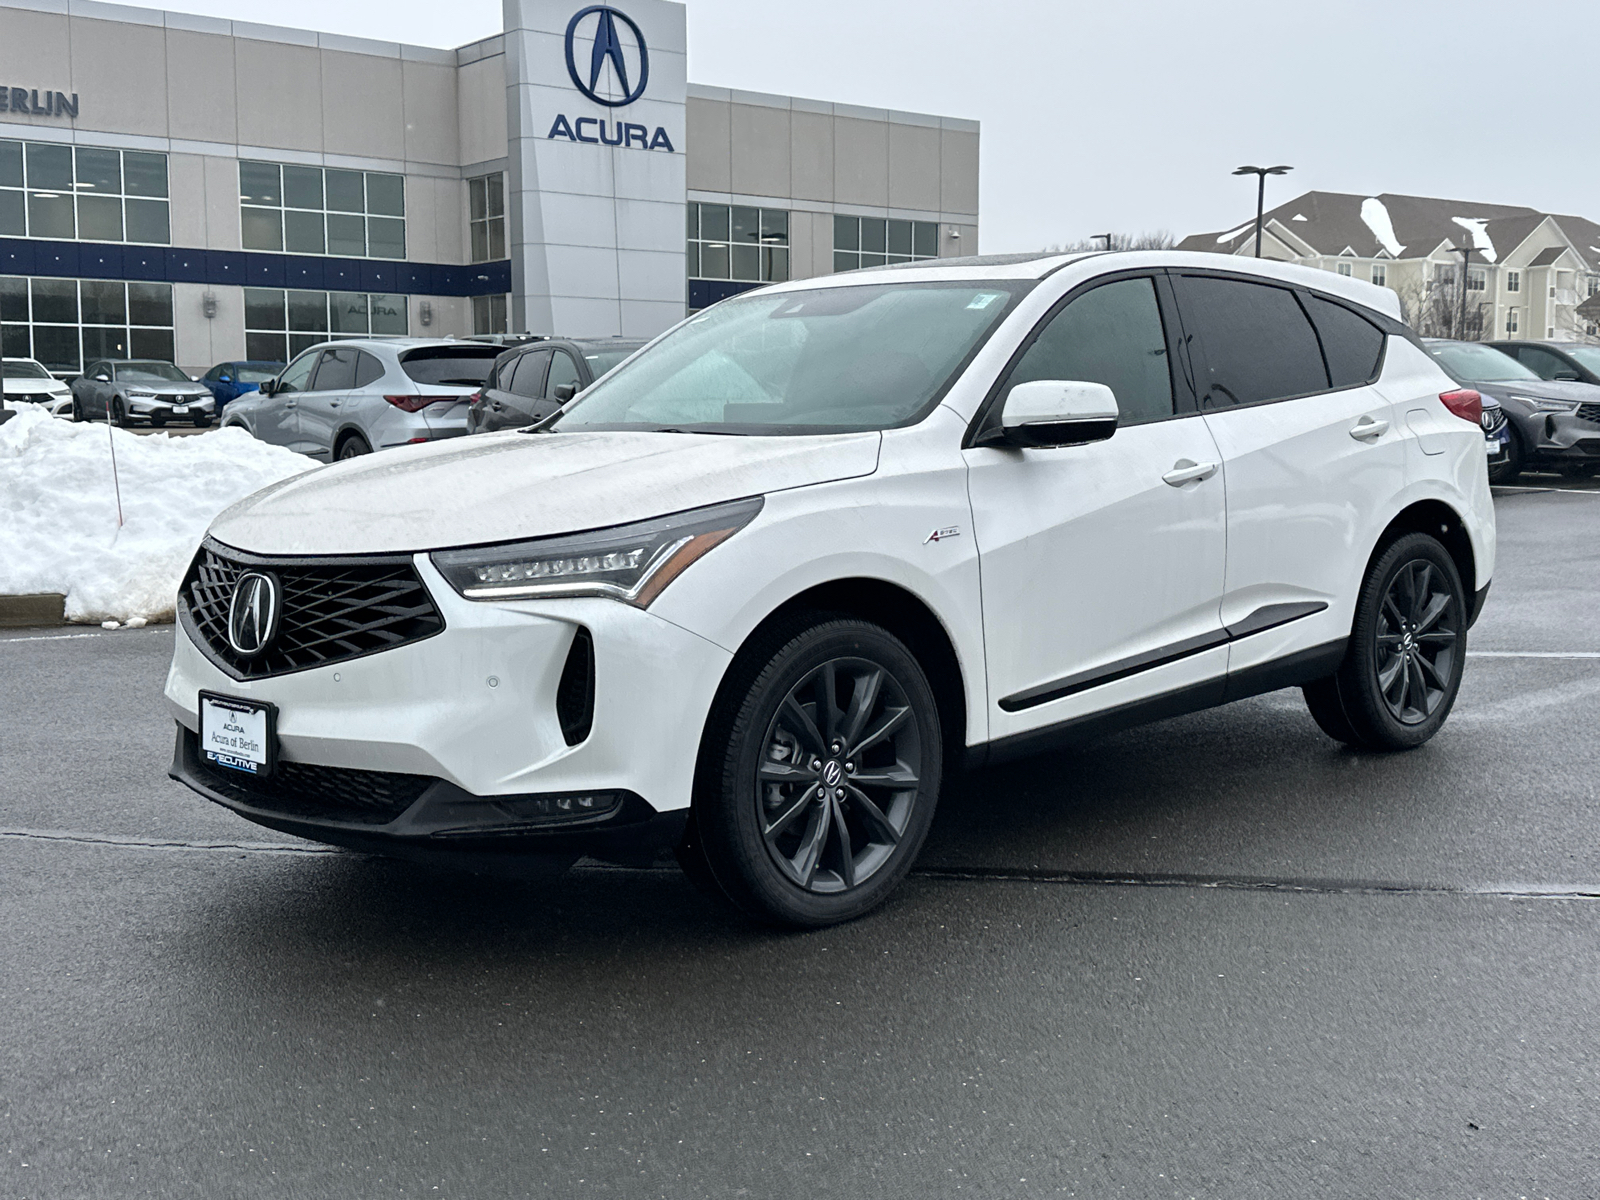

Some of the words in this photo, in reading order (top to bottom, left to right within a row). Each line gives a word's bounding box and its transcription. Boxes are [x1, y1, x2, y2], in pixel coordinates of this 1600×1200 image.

[547, 113, 675, 152] ACURA
[223, 723, 245, 734] ACURA
[211, 731, 230, 746] Acura
[230, 737, 238, 748] of
[239, 737, 259, 753] Berlin
[207, 751, 257, 771] EXECUTIVE
